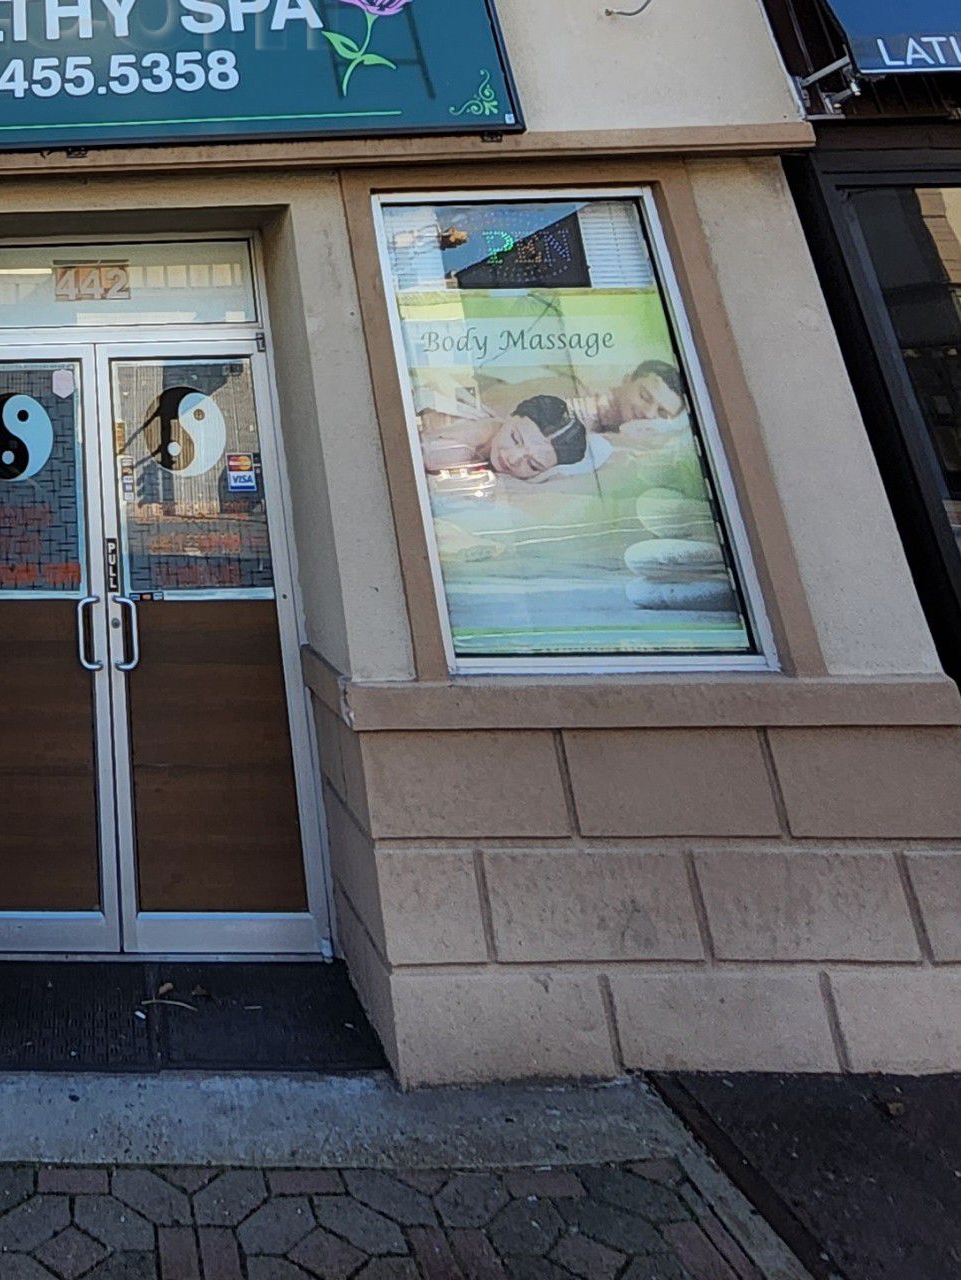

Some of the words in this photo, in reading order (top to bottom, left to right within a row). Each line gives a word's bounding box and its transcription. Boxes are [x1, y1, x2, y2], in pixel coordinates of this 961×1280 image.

[56, 267, 129, 299] 442
[421, 327, 488, 359] Body
[499, 330, 614, 357] Massage
[233, 475, 253, 483] VISA
[107, 542, 118, 589] PULL
